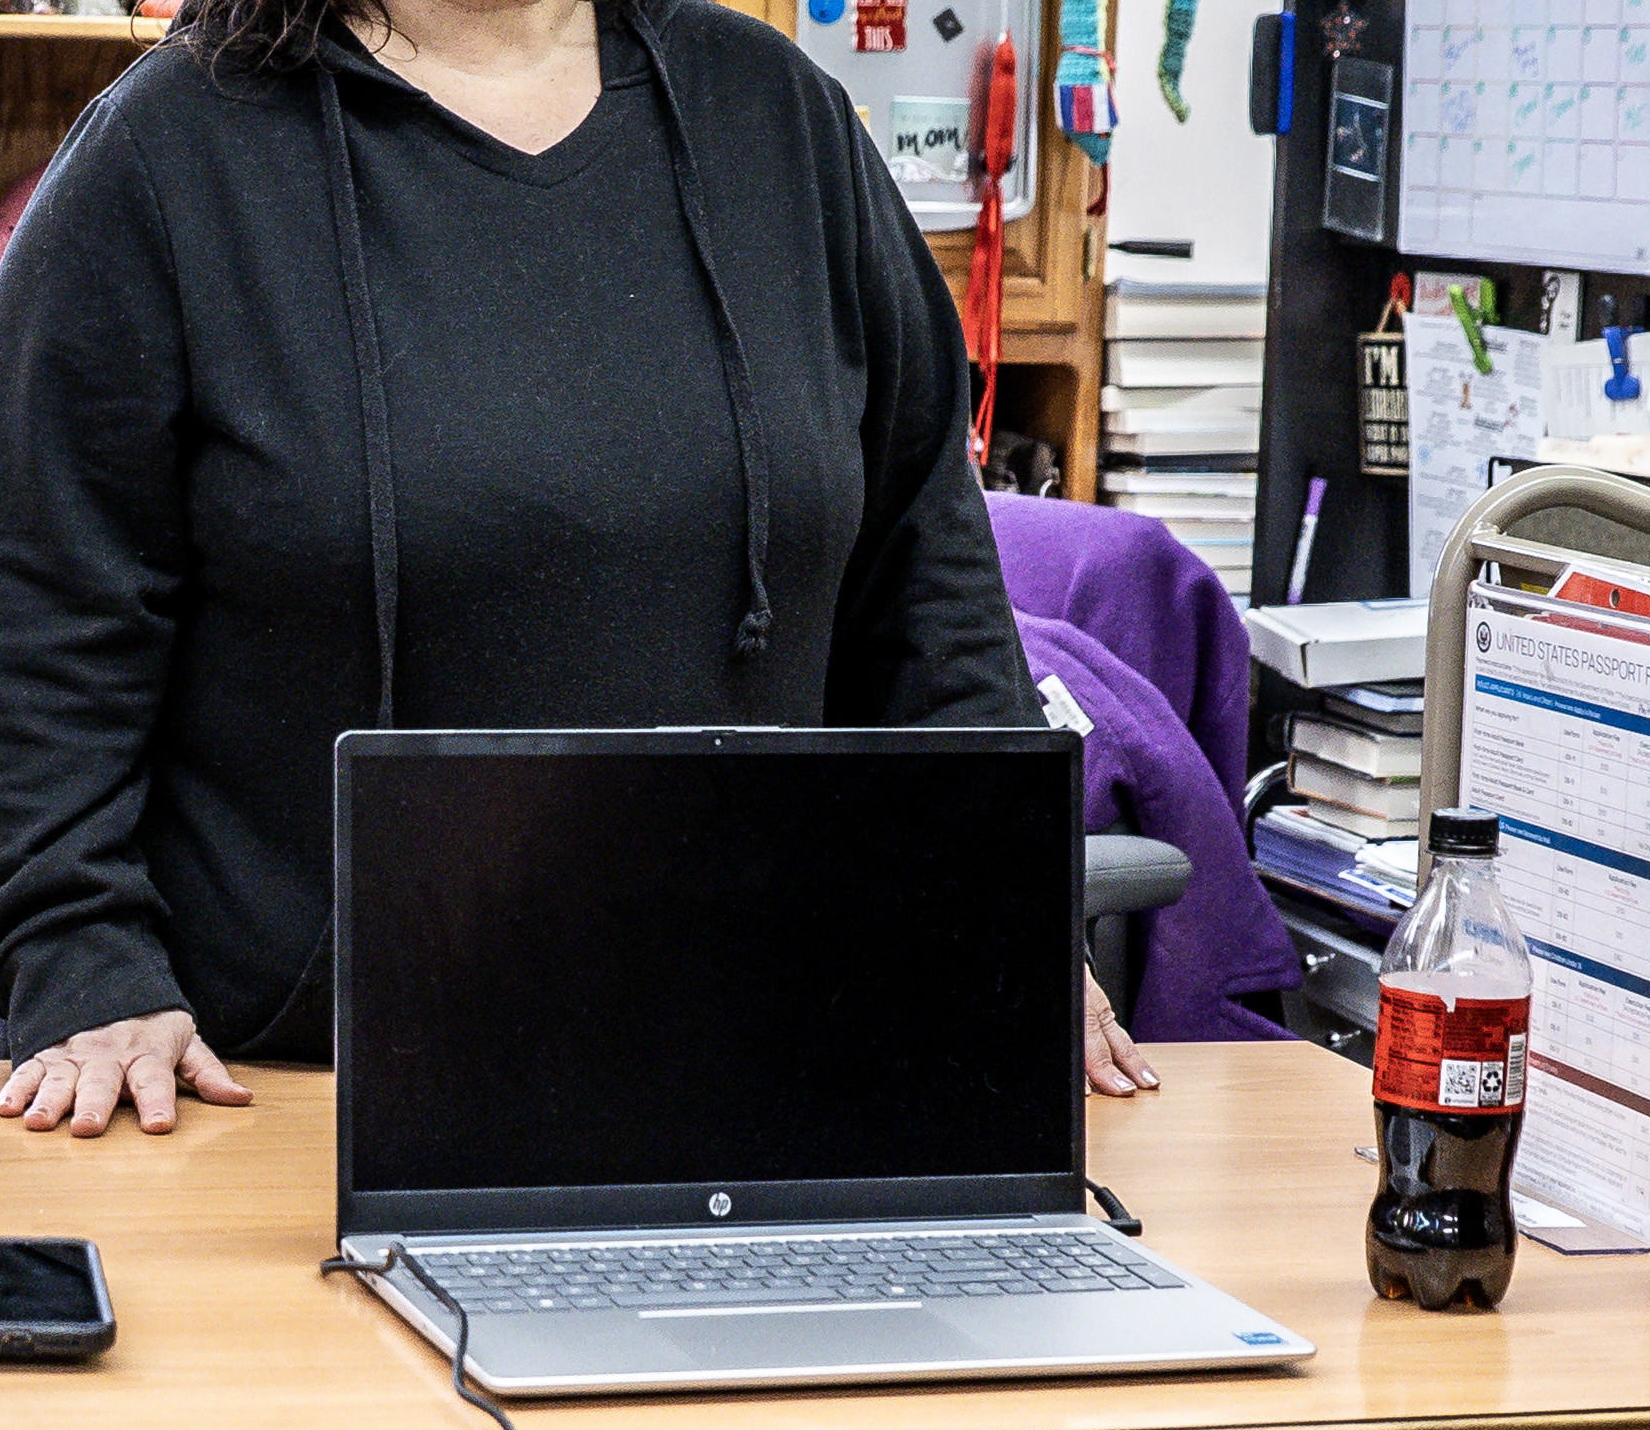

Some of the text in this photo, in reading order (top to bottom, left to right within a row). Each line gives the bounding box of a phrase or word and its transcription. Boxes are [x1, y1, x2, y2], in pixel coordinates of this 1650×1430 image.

[1496, 630, 1536, 659] UNITED
[1538, 640, 1579, 668] STATES
[1581, 650, 1642, 683] PASSPORT
